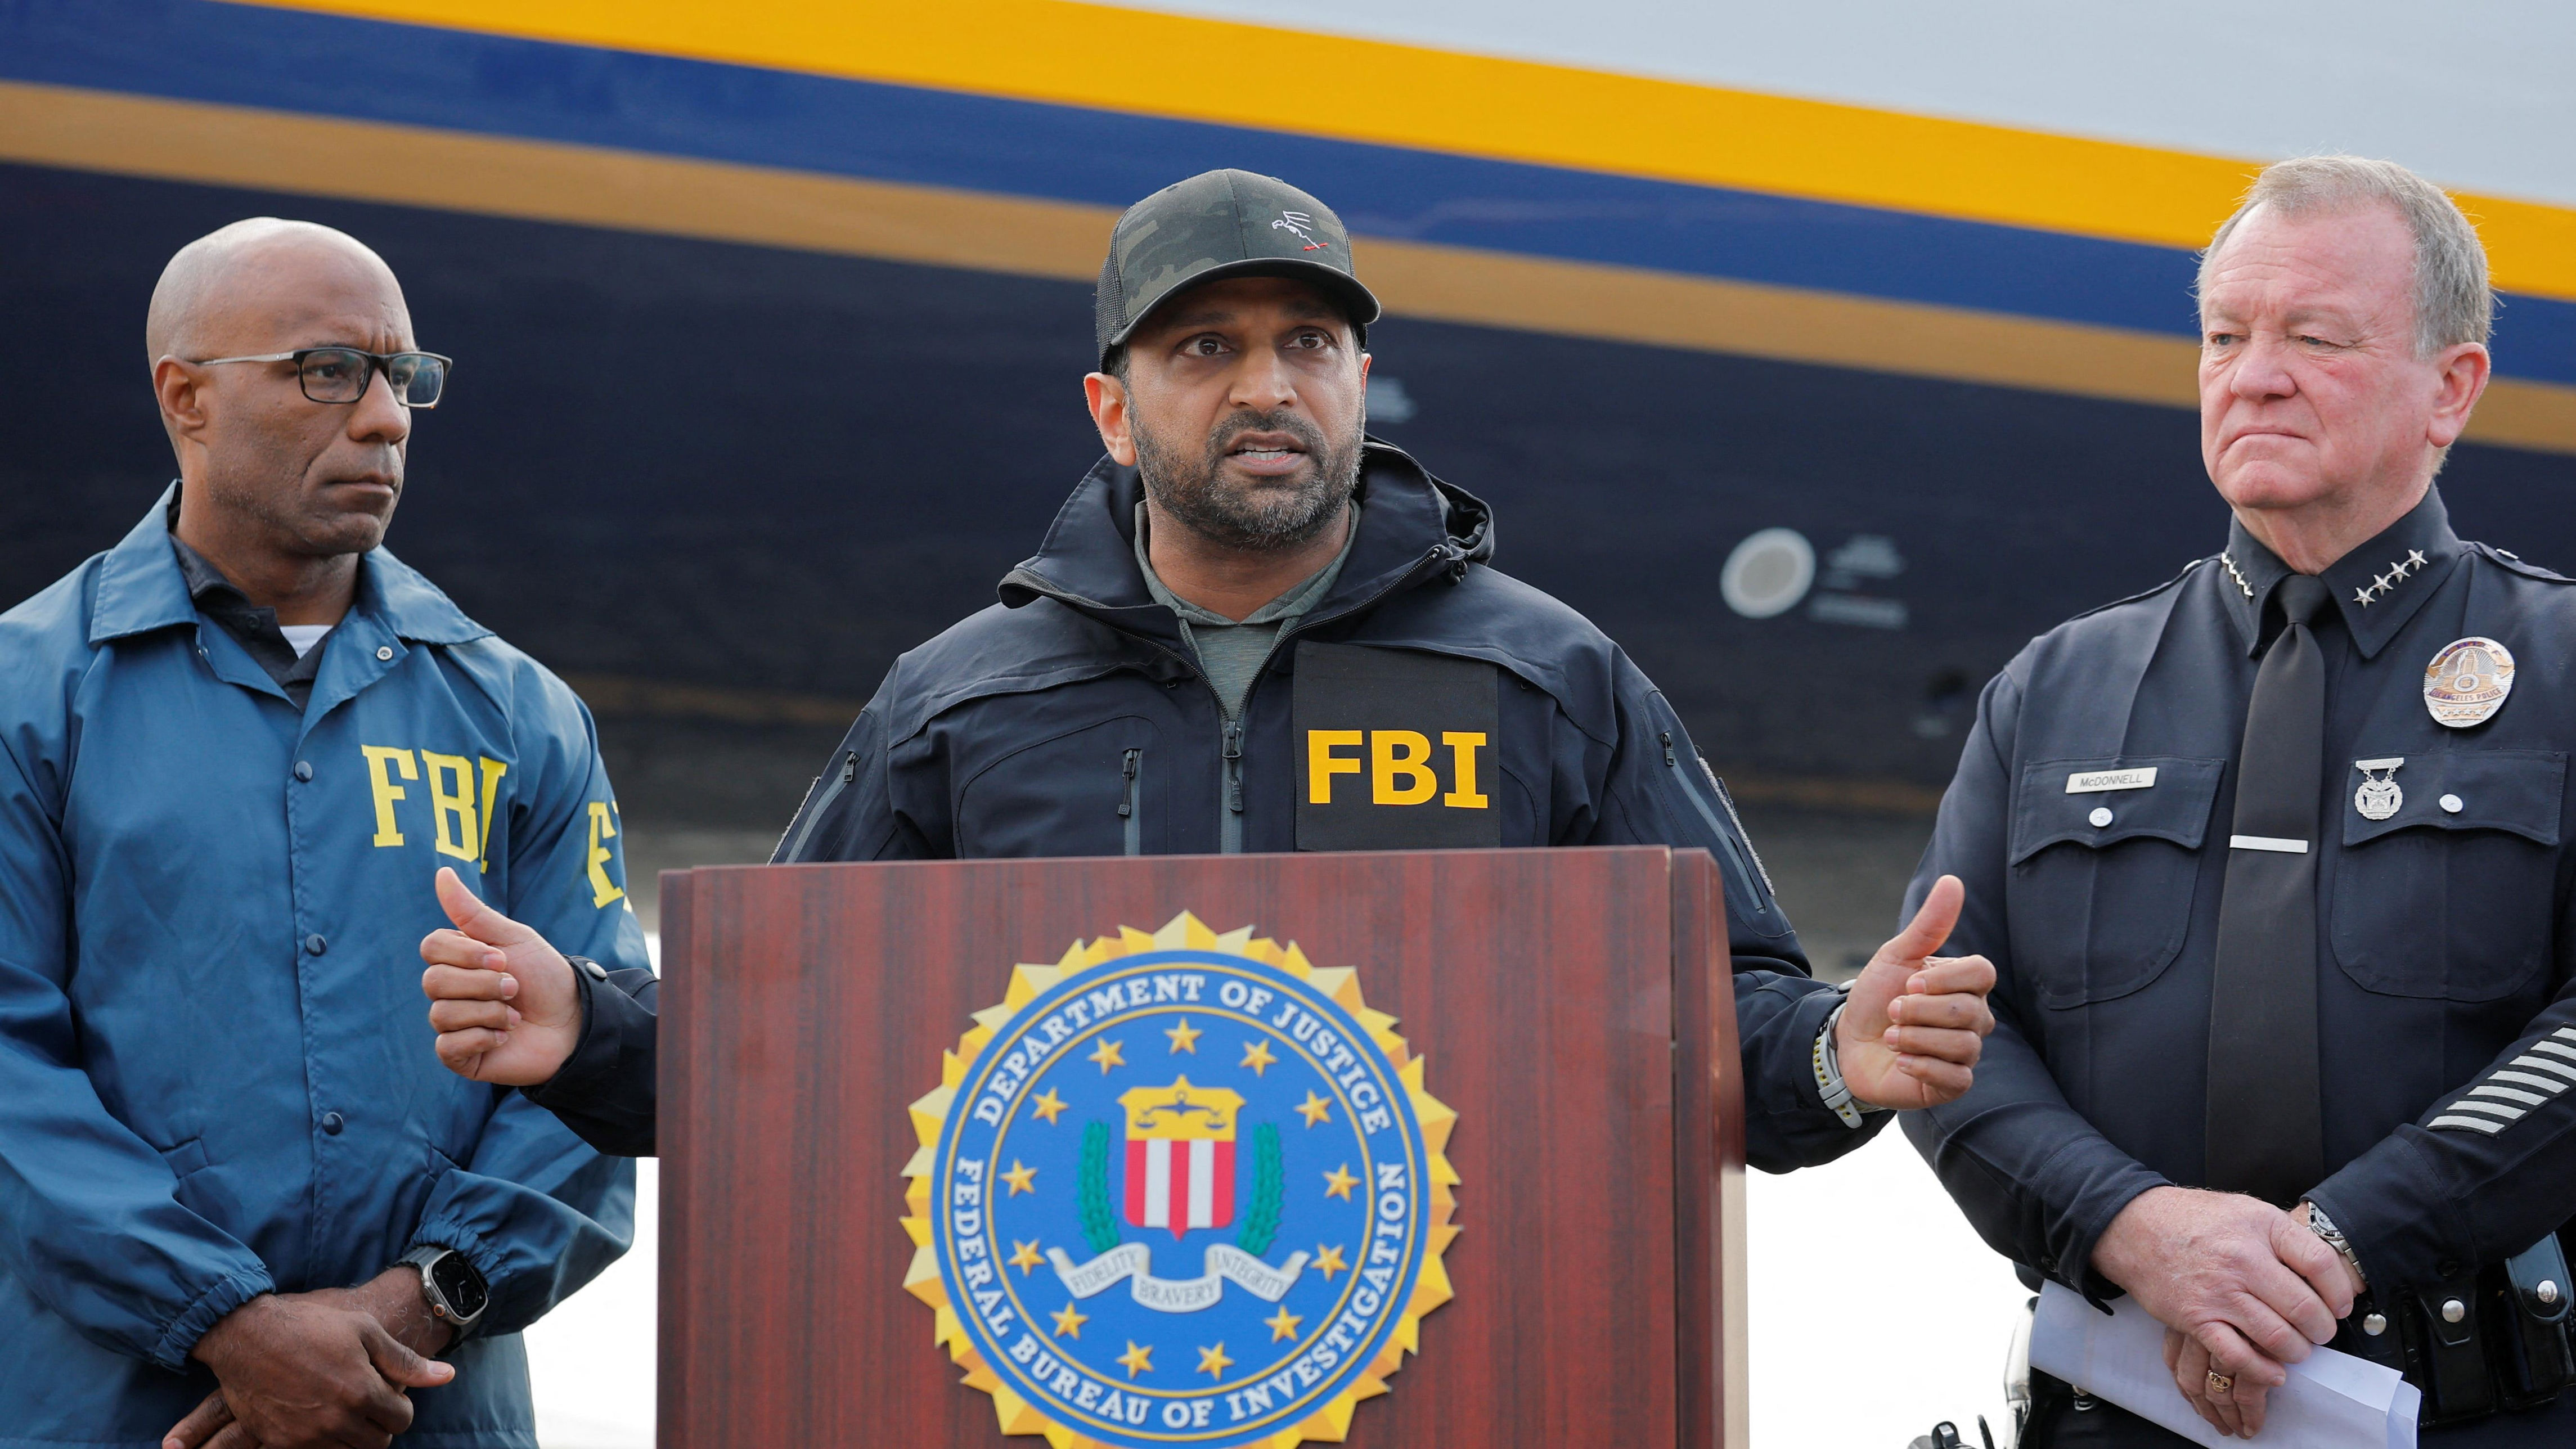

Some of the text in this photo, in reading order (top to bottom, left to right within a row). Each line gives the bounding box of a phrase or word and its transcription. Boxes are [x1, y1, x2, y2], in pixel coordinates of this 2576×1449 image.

[2476, 687, 2502, 701] POLICE
[1308, 730, 1488, 809] FBI
[2080, 773, 2142, 786] McDONNELL
[361, 744, 507, 874] FBI
[974, 974, 1392, 1135] DEPARTMENT OF JUSTICE
[954, 1157, 1406, 1428] FEDERAL BUREAU OF INVESTIGATION
[1070, 1251, 1139, 1293] FIDELITY
[1139, 1281, 1216, 1306] BRAVERY
[1213, 1251, 1285, 1295] INTEGRITY
